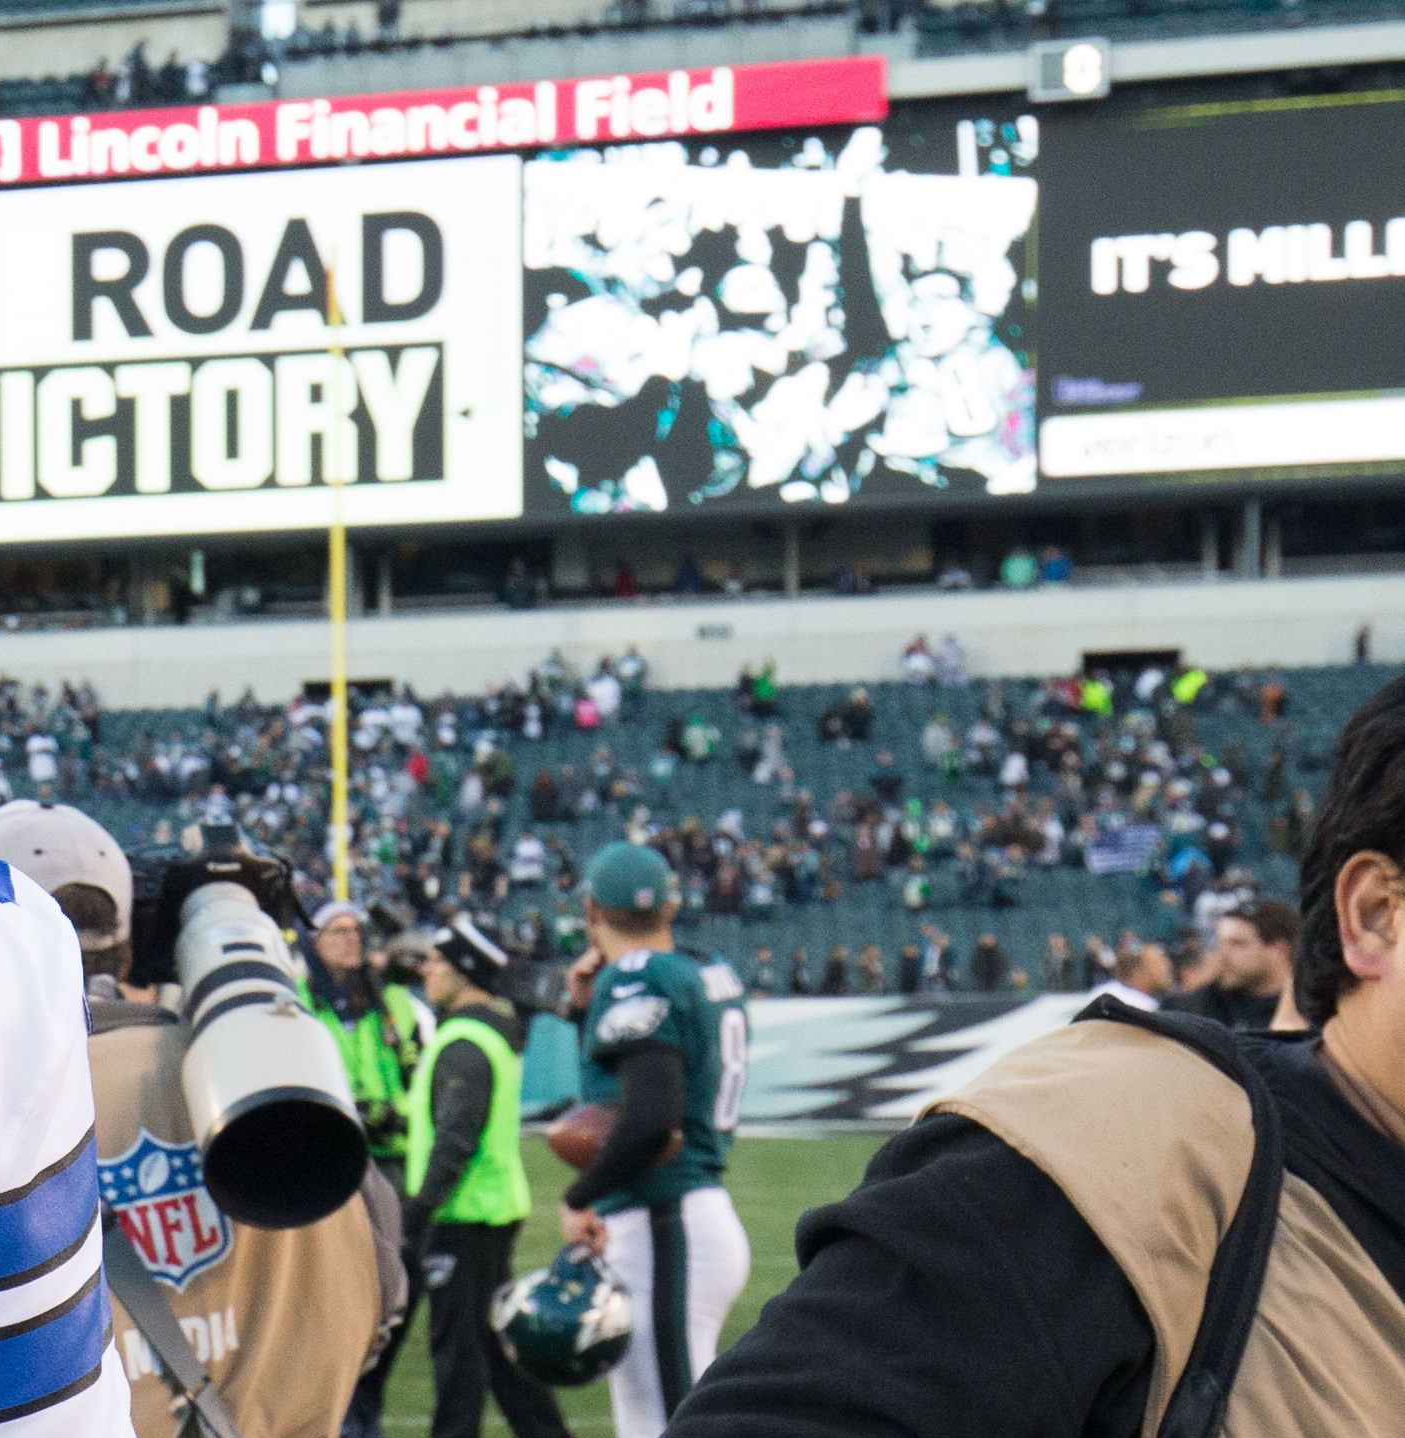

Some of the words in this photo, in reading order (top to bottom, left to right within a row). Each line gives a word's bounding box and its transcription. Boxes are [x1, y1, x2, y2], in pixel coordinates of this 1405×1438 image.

[39, 106, 260, 177] Lincoln
[276, 81, 557, 161] Financial
[575, 67, 733, 140] Field
[71, 211, 445, 342] ROAD
[1091, 231, 1219, 295] IT'S
[116, 1194, 221, 1268] NFL
[123, 1304, 240, 1381] MDIA
